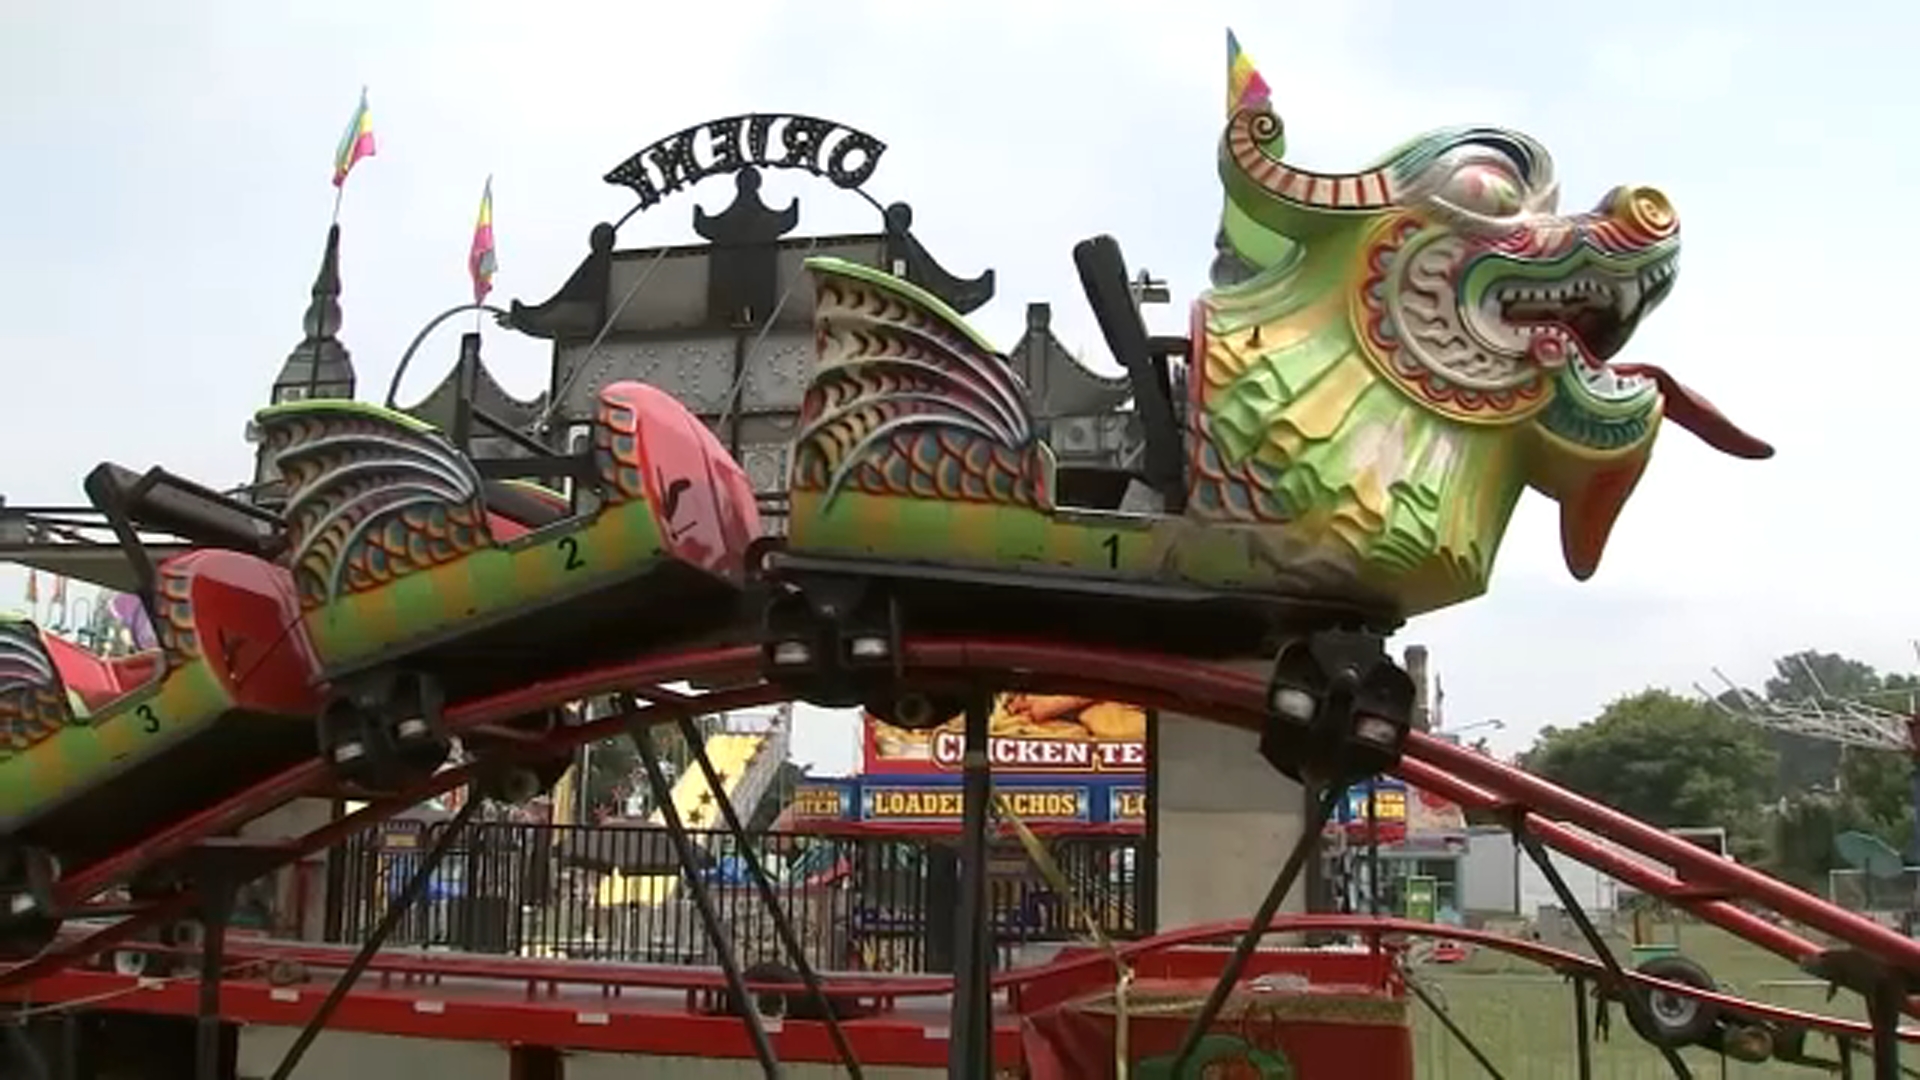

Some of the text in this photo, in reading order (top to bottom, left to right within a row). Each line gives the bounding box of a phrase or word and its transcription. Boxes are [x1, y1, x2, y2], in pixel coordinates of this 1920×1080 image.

[557, 535, 586, 570] 2
[1102, 533, 1118, 568] 1
[135, 702, 160, 733] 3
